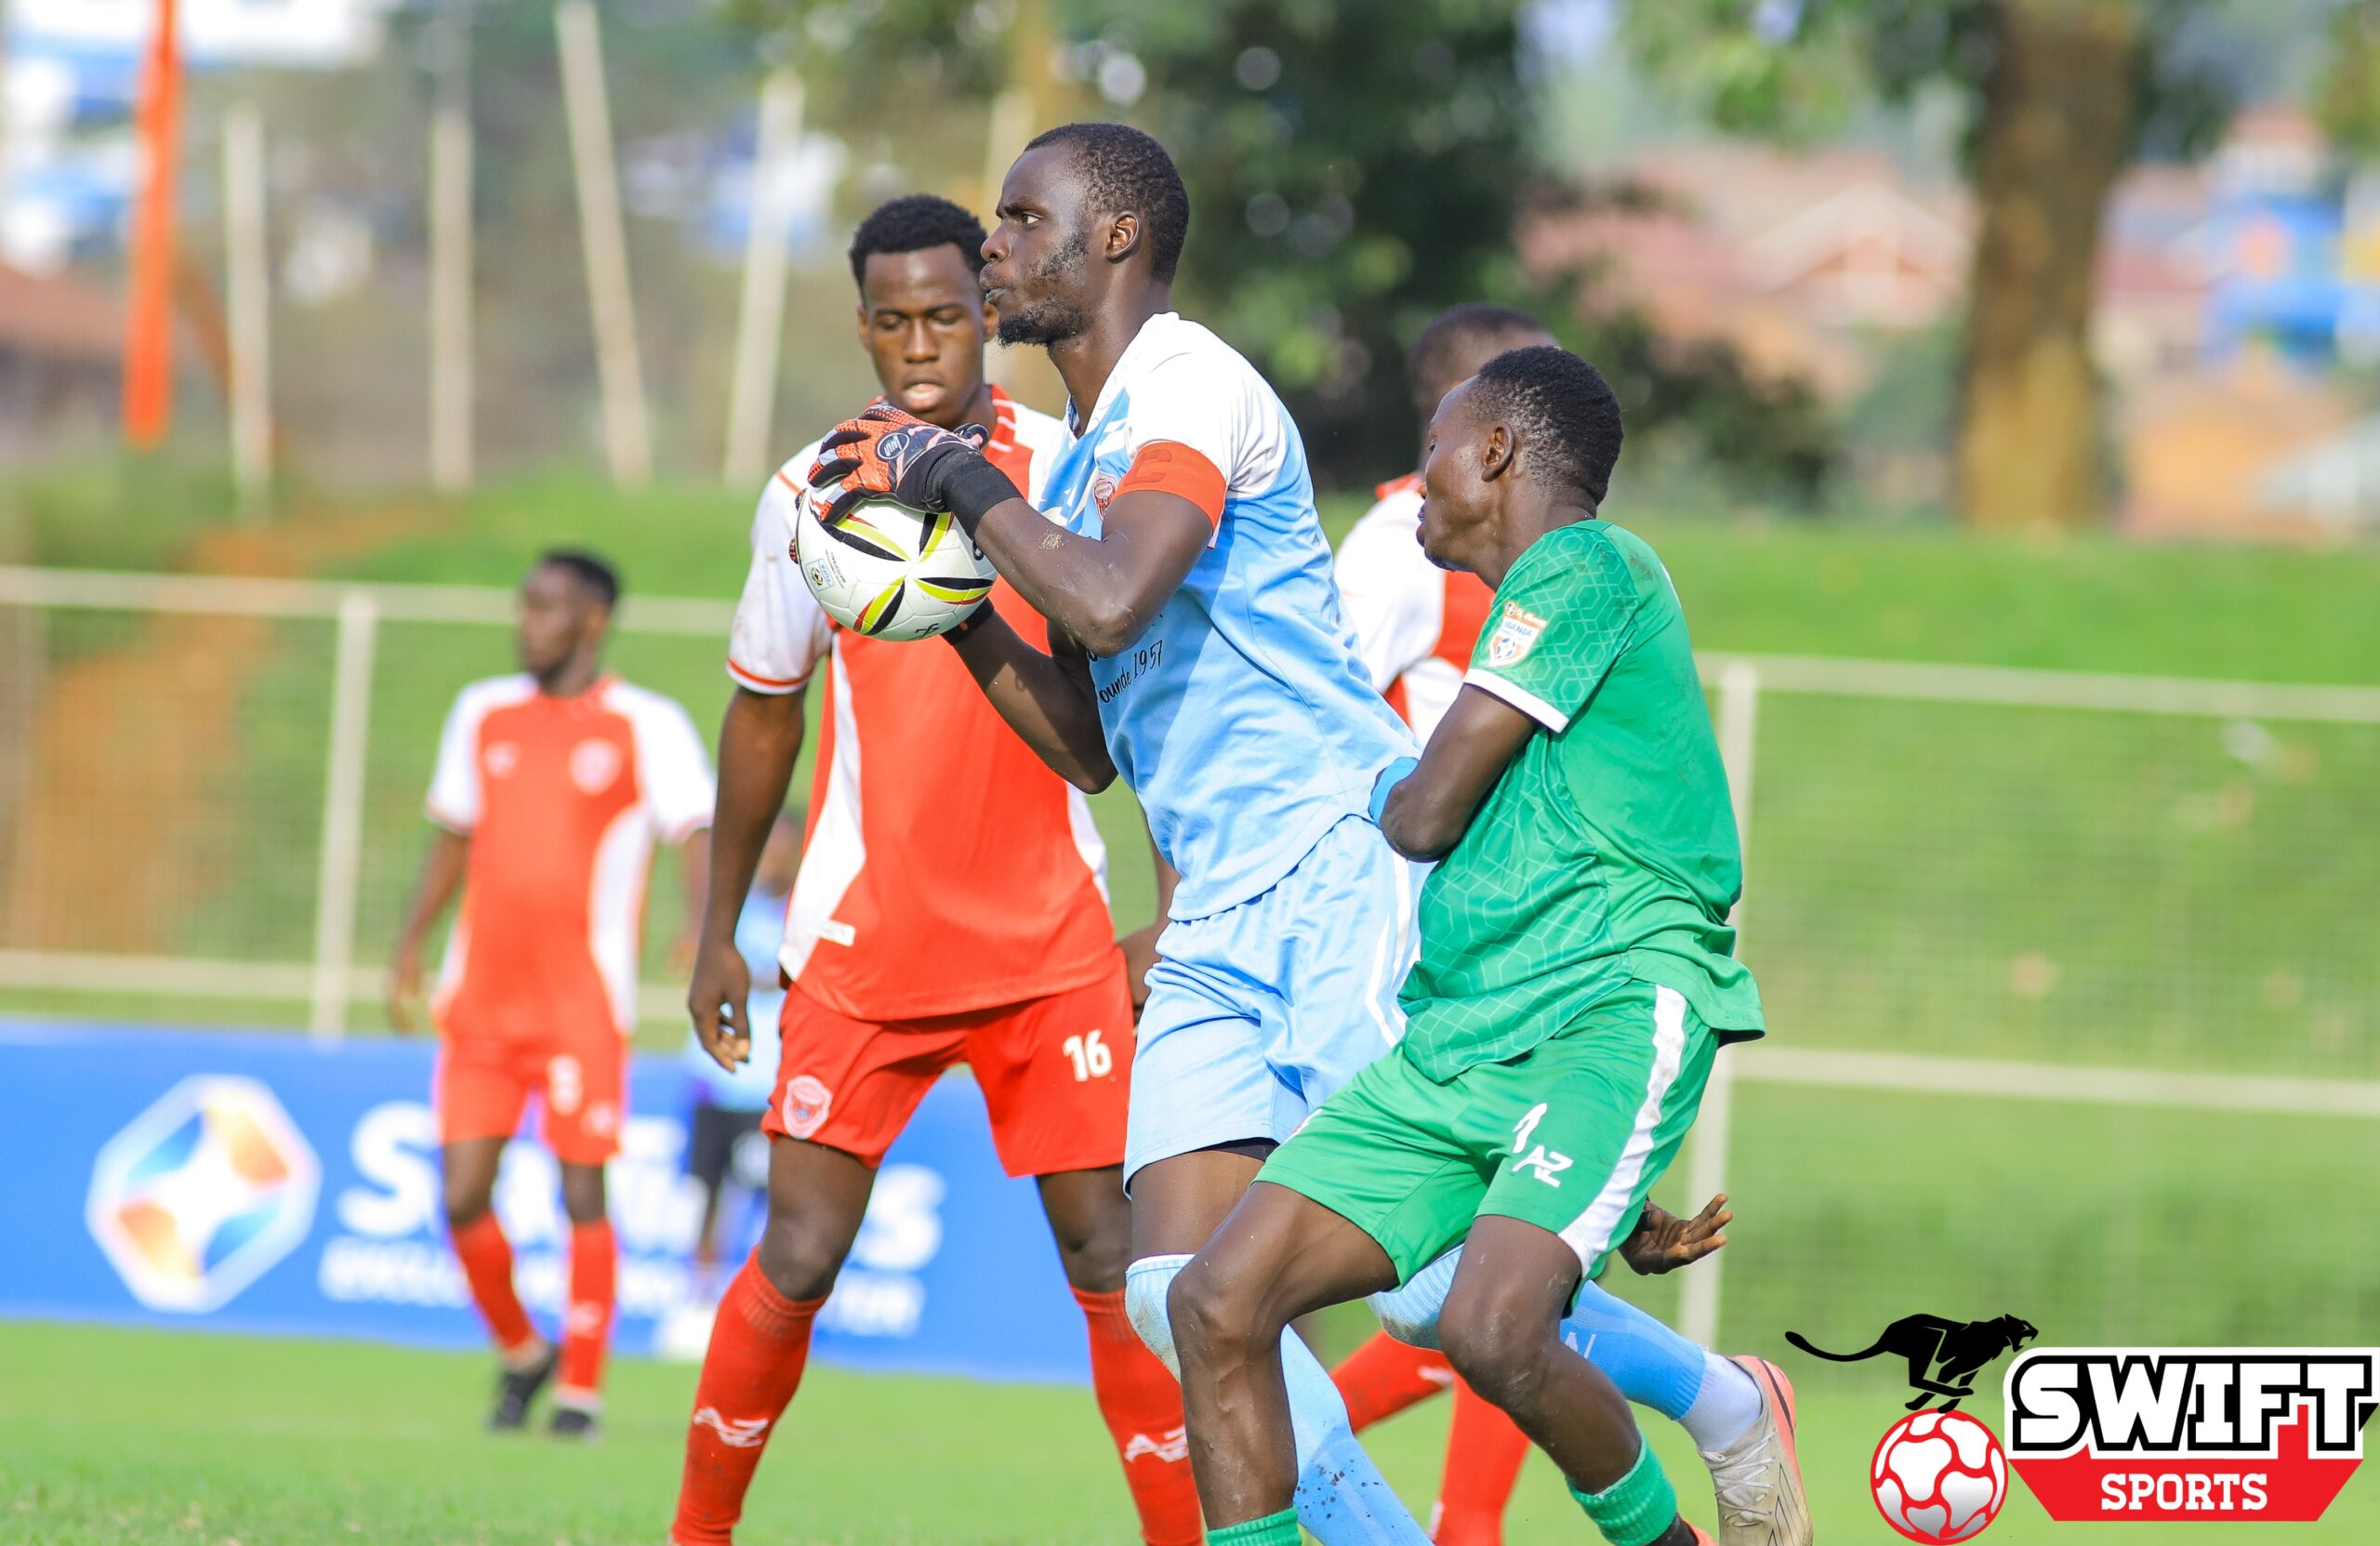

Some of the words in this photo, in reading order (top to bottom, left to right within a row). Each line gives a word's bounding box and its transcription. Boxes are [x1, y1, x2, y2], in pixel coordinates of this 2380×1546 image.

[1099, 667, 1131, 704] ounde
[1133, 639, 1163, 679] 1957
[1062, 1028, 1113, 1082] 16
